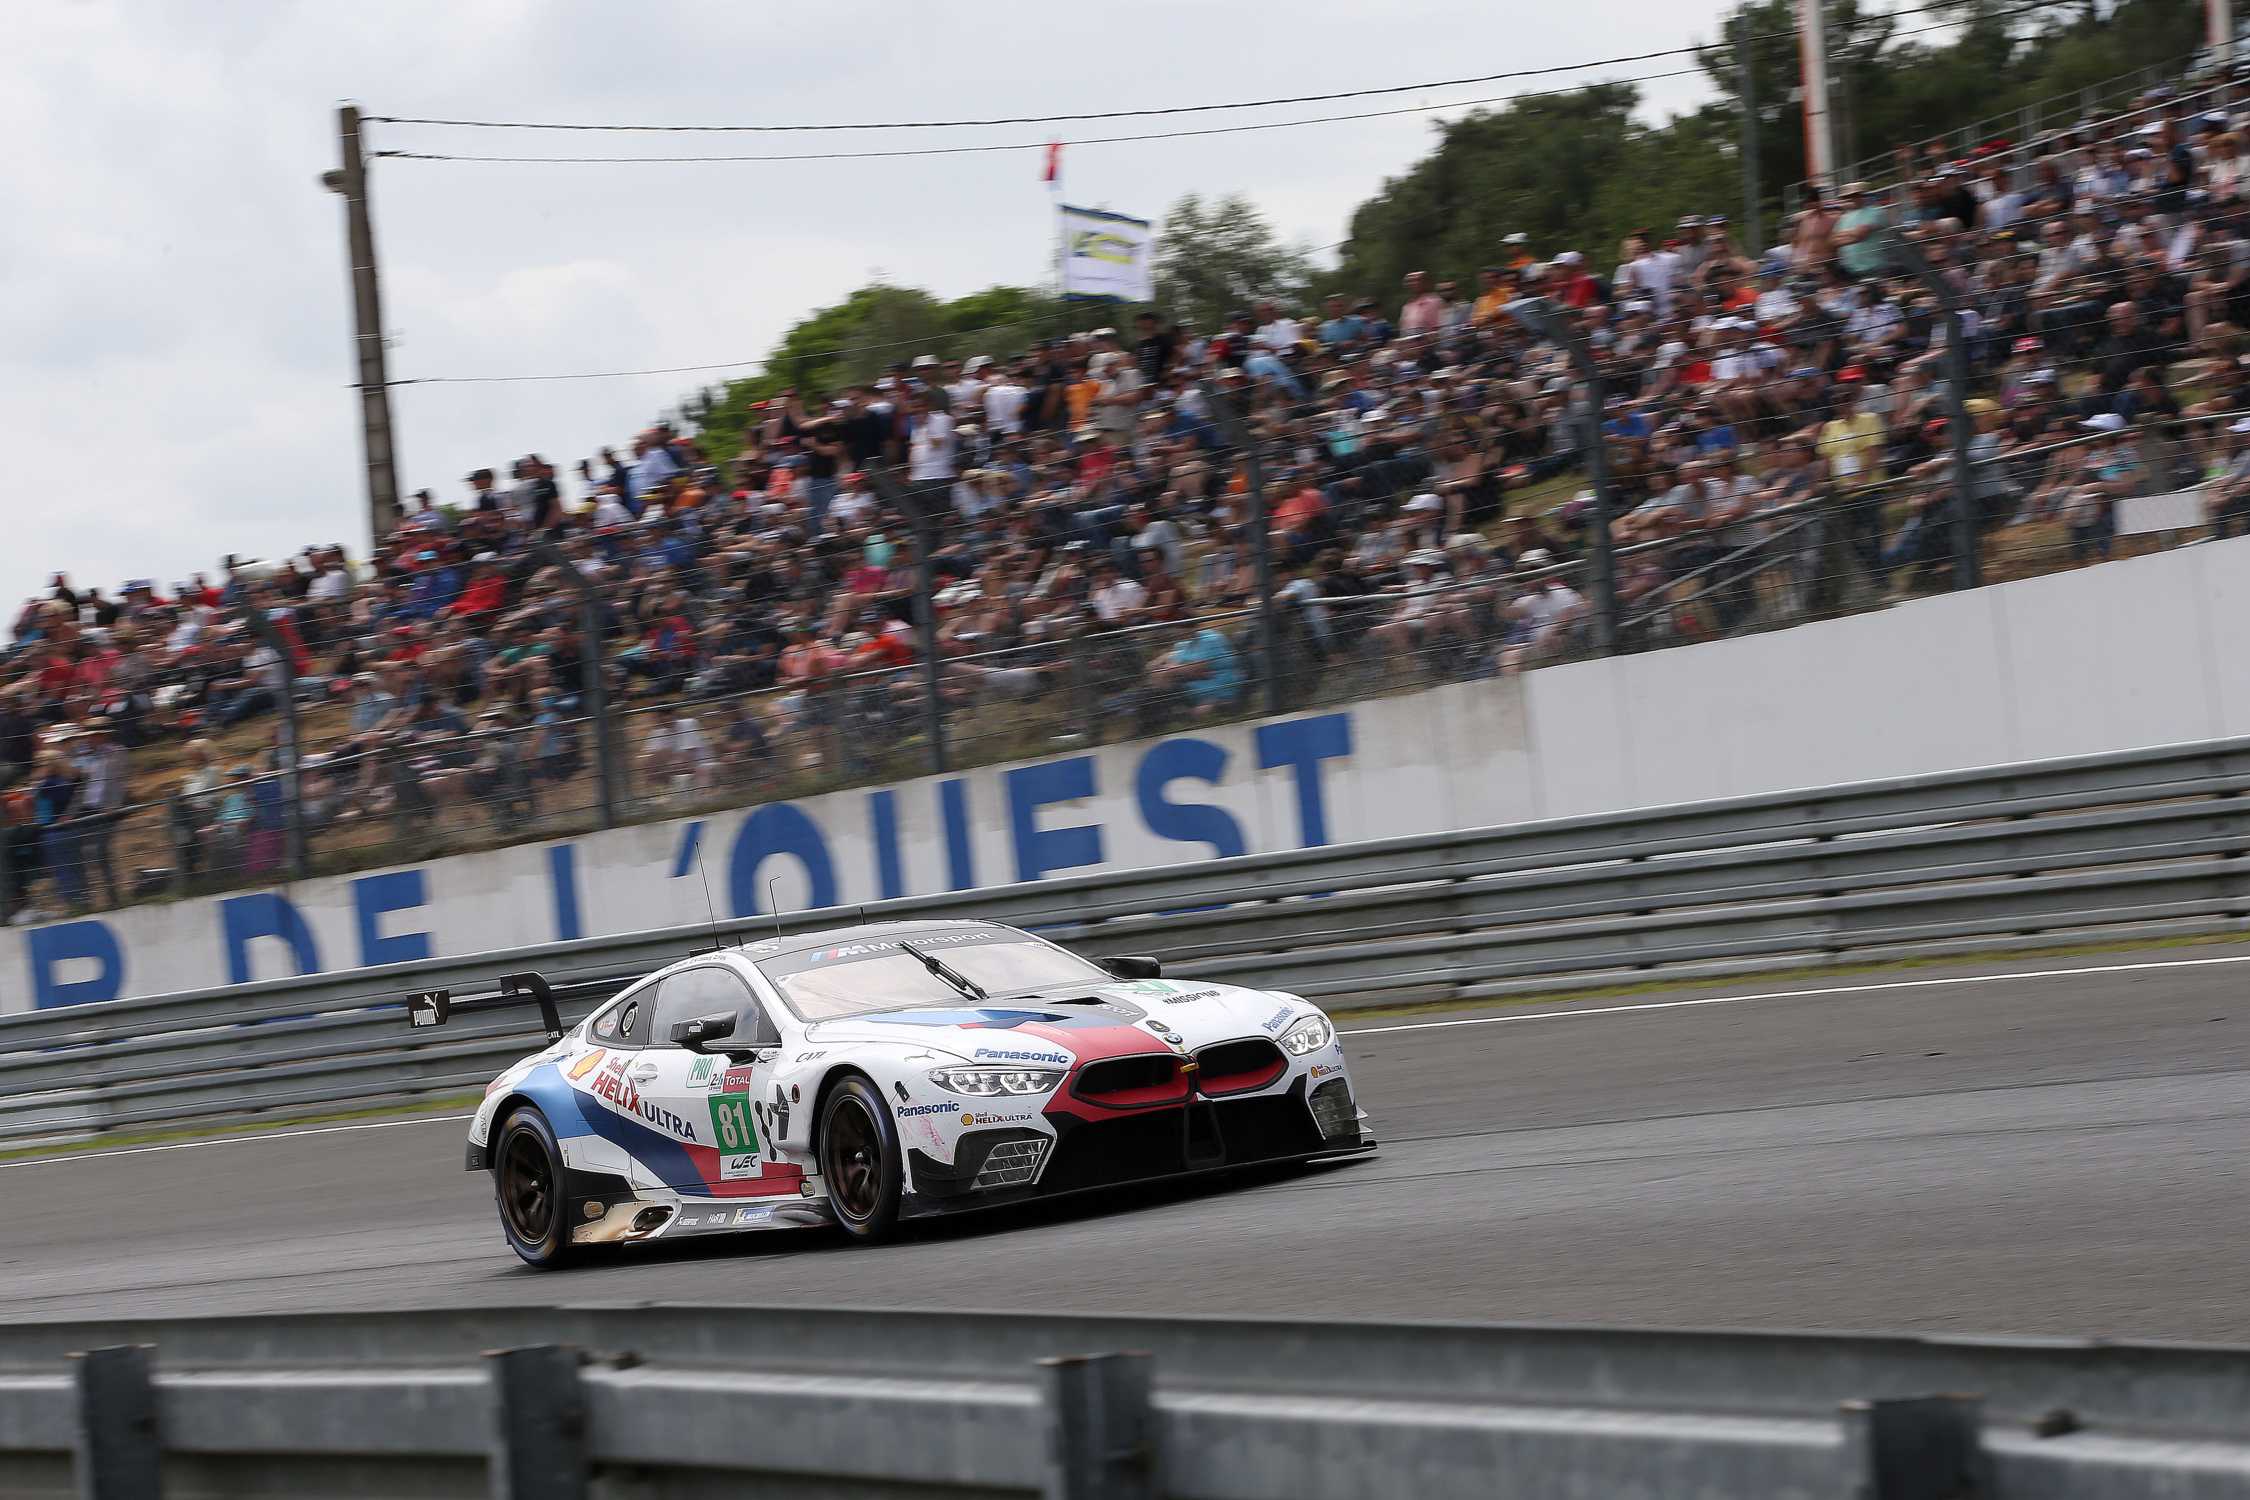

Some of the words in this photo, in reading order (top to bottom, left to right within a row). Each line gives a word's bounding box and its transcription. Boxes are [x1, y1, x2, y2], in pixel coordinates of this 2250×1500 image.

[869, 931, 996, 953] Motorsport
[413, 1008, 437, 1026] PUMA
[974, 1048, 1069, 1064] Panasonic
[689, 1056, 714, 1082] PRO
[725, 1074, 751, 1086] TOTAL
[590, 1070, 642, 1118] HELIX
[642, 1100, 697, 1143] ULTRA
[897, 1100, 960, 1118] Panasonic
[718, 1101, 751, 1149] 81
[975, 1114, 1004, 1124] HELIX
[1005, 1114, 1033, 1123] ULTRA
[731, 1154, 758, 1170] WEC
